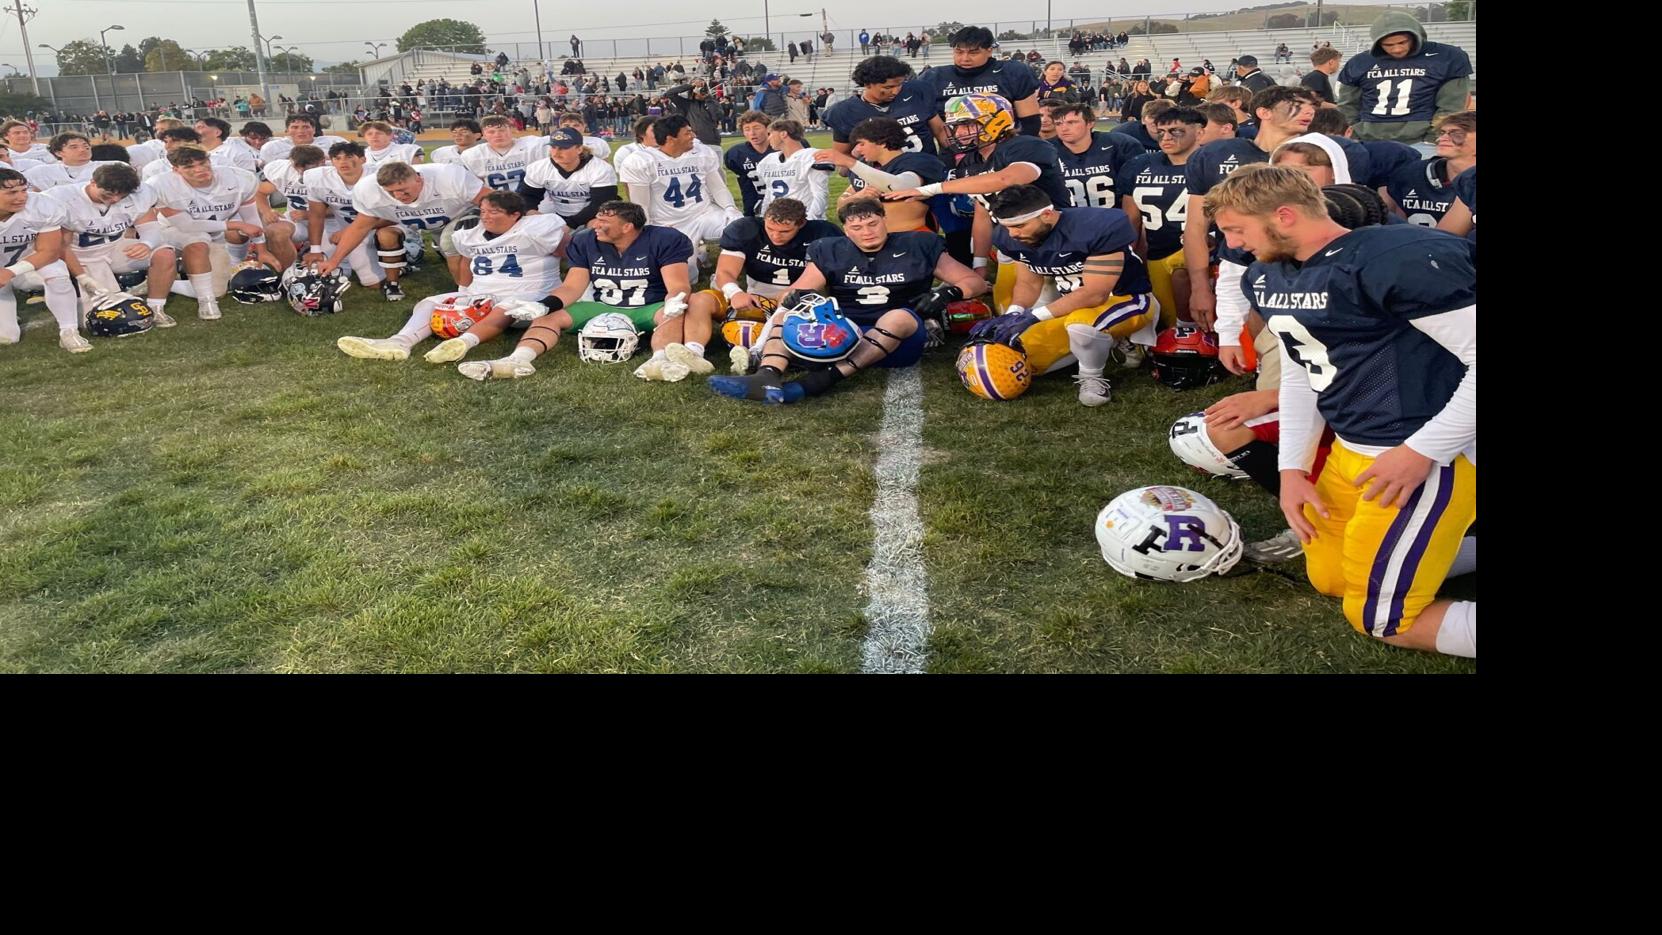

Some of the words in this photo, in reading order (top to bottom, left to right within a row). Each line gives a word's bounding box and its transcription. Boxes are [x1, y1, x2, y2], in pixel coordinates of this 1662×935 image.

[1367, 70, 1383, 78] FCA
[1384, 69, 1399, 77] ALL
[1400, 68, 1426, 76] STARS
[958, 87, 974, 95] ALL
[974, 85, 998, 94] STARS
[1371, 79, 1413, 115] 11
[897, 115, 920, 126] STARS
[507, 161, 526, 169] STARS
[682, 165, 700, 173] STARS
[1071, 168, 1086, 177] ALL
[1086, 165, 1110, 175] STARS
[1135, 175, 1151, 184] FCA
[1151, 175, 1170, 184] ALL
[663, 173, 704, 208] 44
[1133, 187, 1188, 230] 54
[1402, 199, 1420, 209] FCA
[1421, 200, 1436, 211] ALL
[423, 207, 446, 216] STARS
[482, 247, 496, 255] ALL
[496, 245, 518, 254] STARS
[756, 252, 771, 263] FCA
[771, 256, 788, 267] ALL
[473, 254, 523, 278] 84
[592, 266, 606, 275] FCA
[606, 268, 622, 277] ALL
[624, 267, 650, 277] STARS
[772, 268, 790, 284] 1
[875, 273, 905, 284] STARS
[855, 286, 891, 304] 3
[1266, 293, 1290, 309] ALL
[1290, 291, 1328, 310] STARS
[1163, 514, 1205, 551] R
